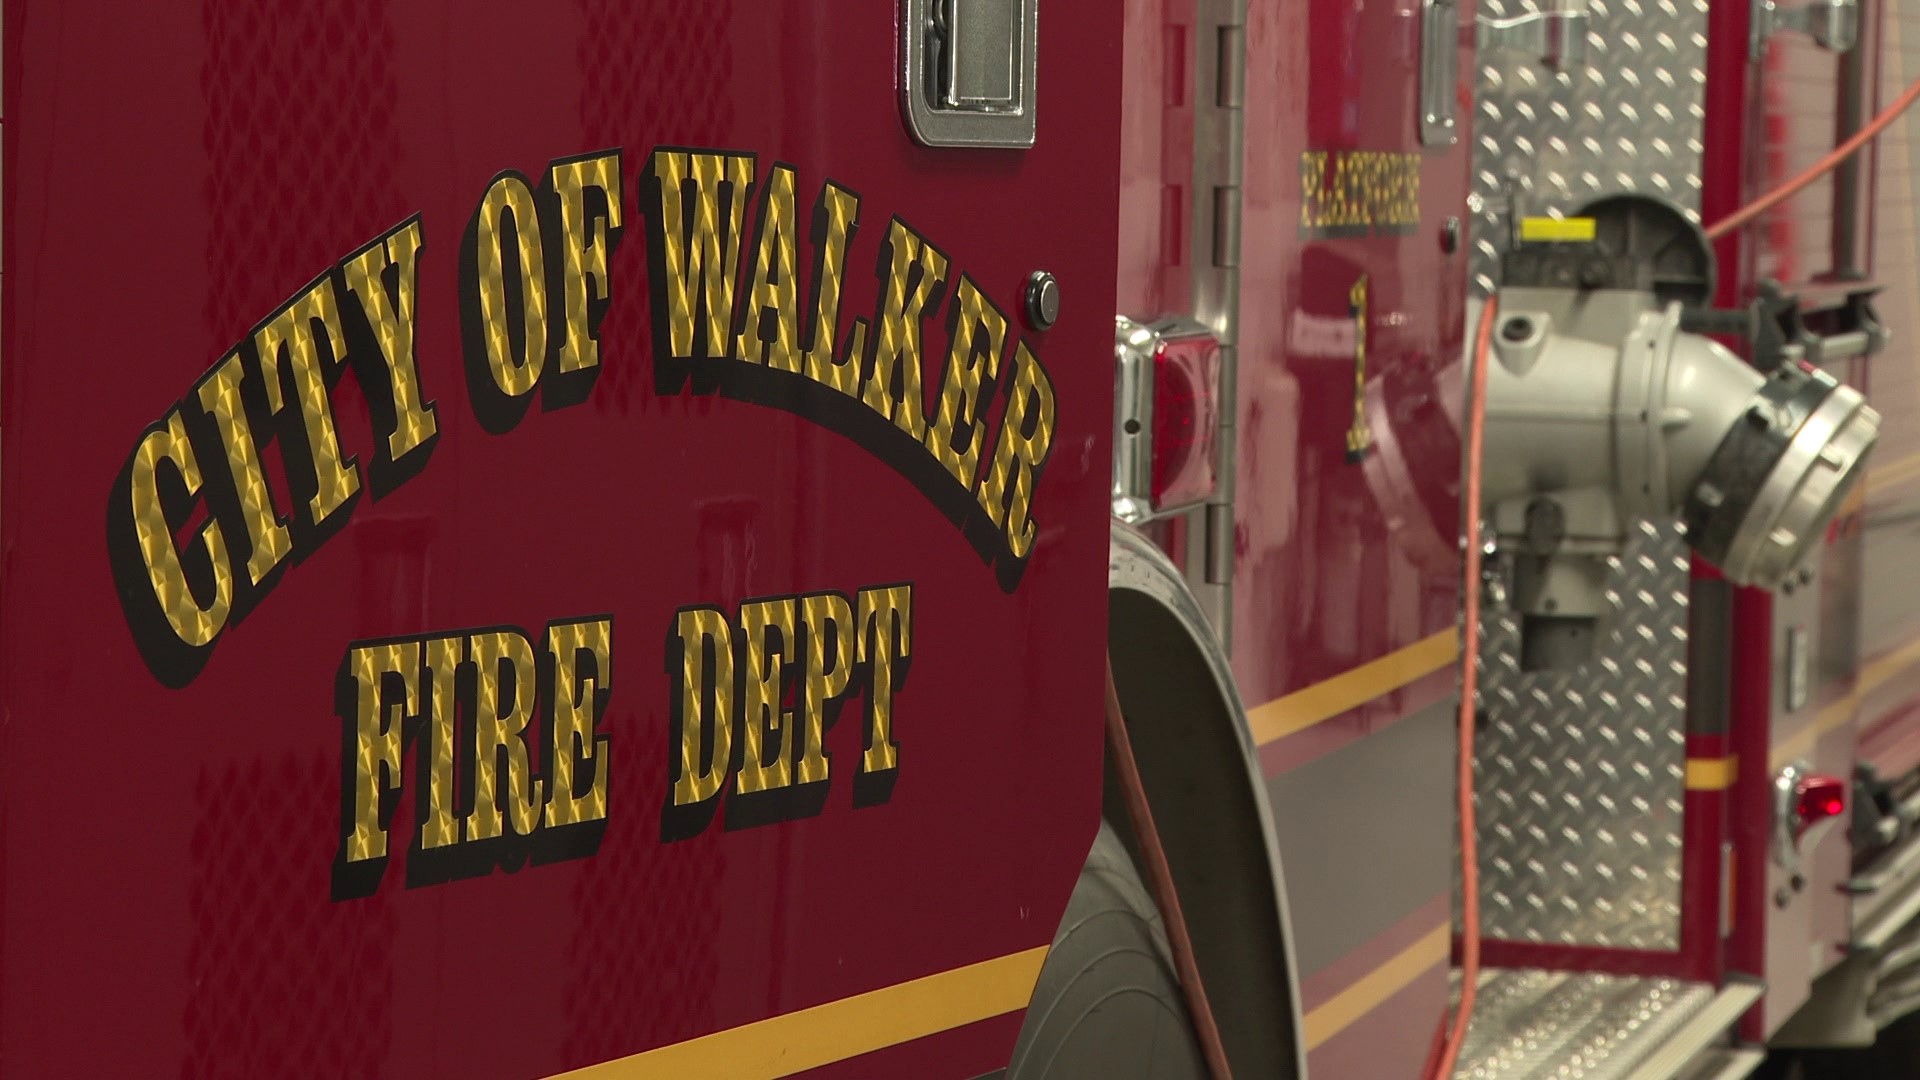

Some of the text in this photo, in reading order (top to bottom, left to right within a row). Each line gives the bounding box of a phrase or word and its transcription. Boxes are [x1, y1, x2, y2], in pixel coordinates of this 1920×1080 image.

[130, 149, 1058, 648] CITY OF WALKER
[345, 584, 912, 863] FIRE DEPT
